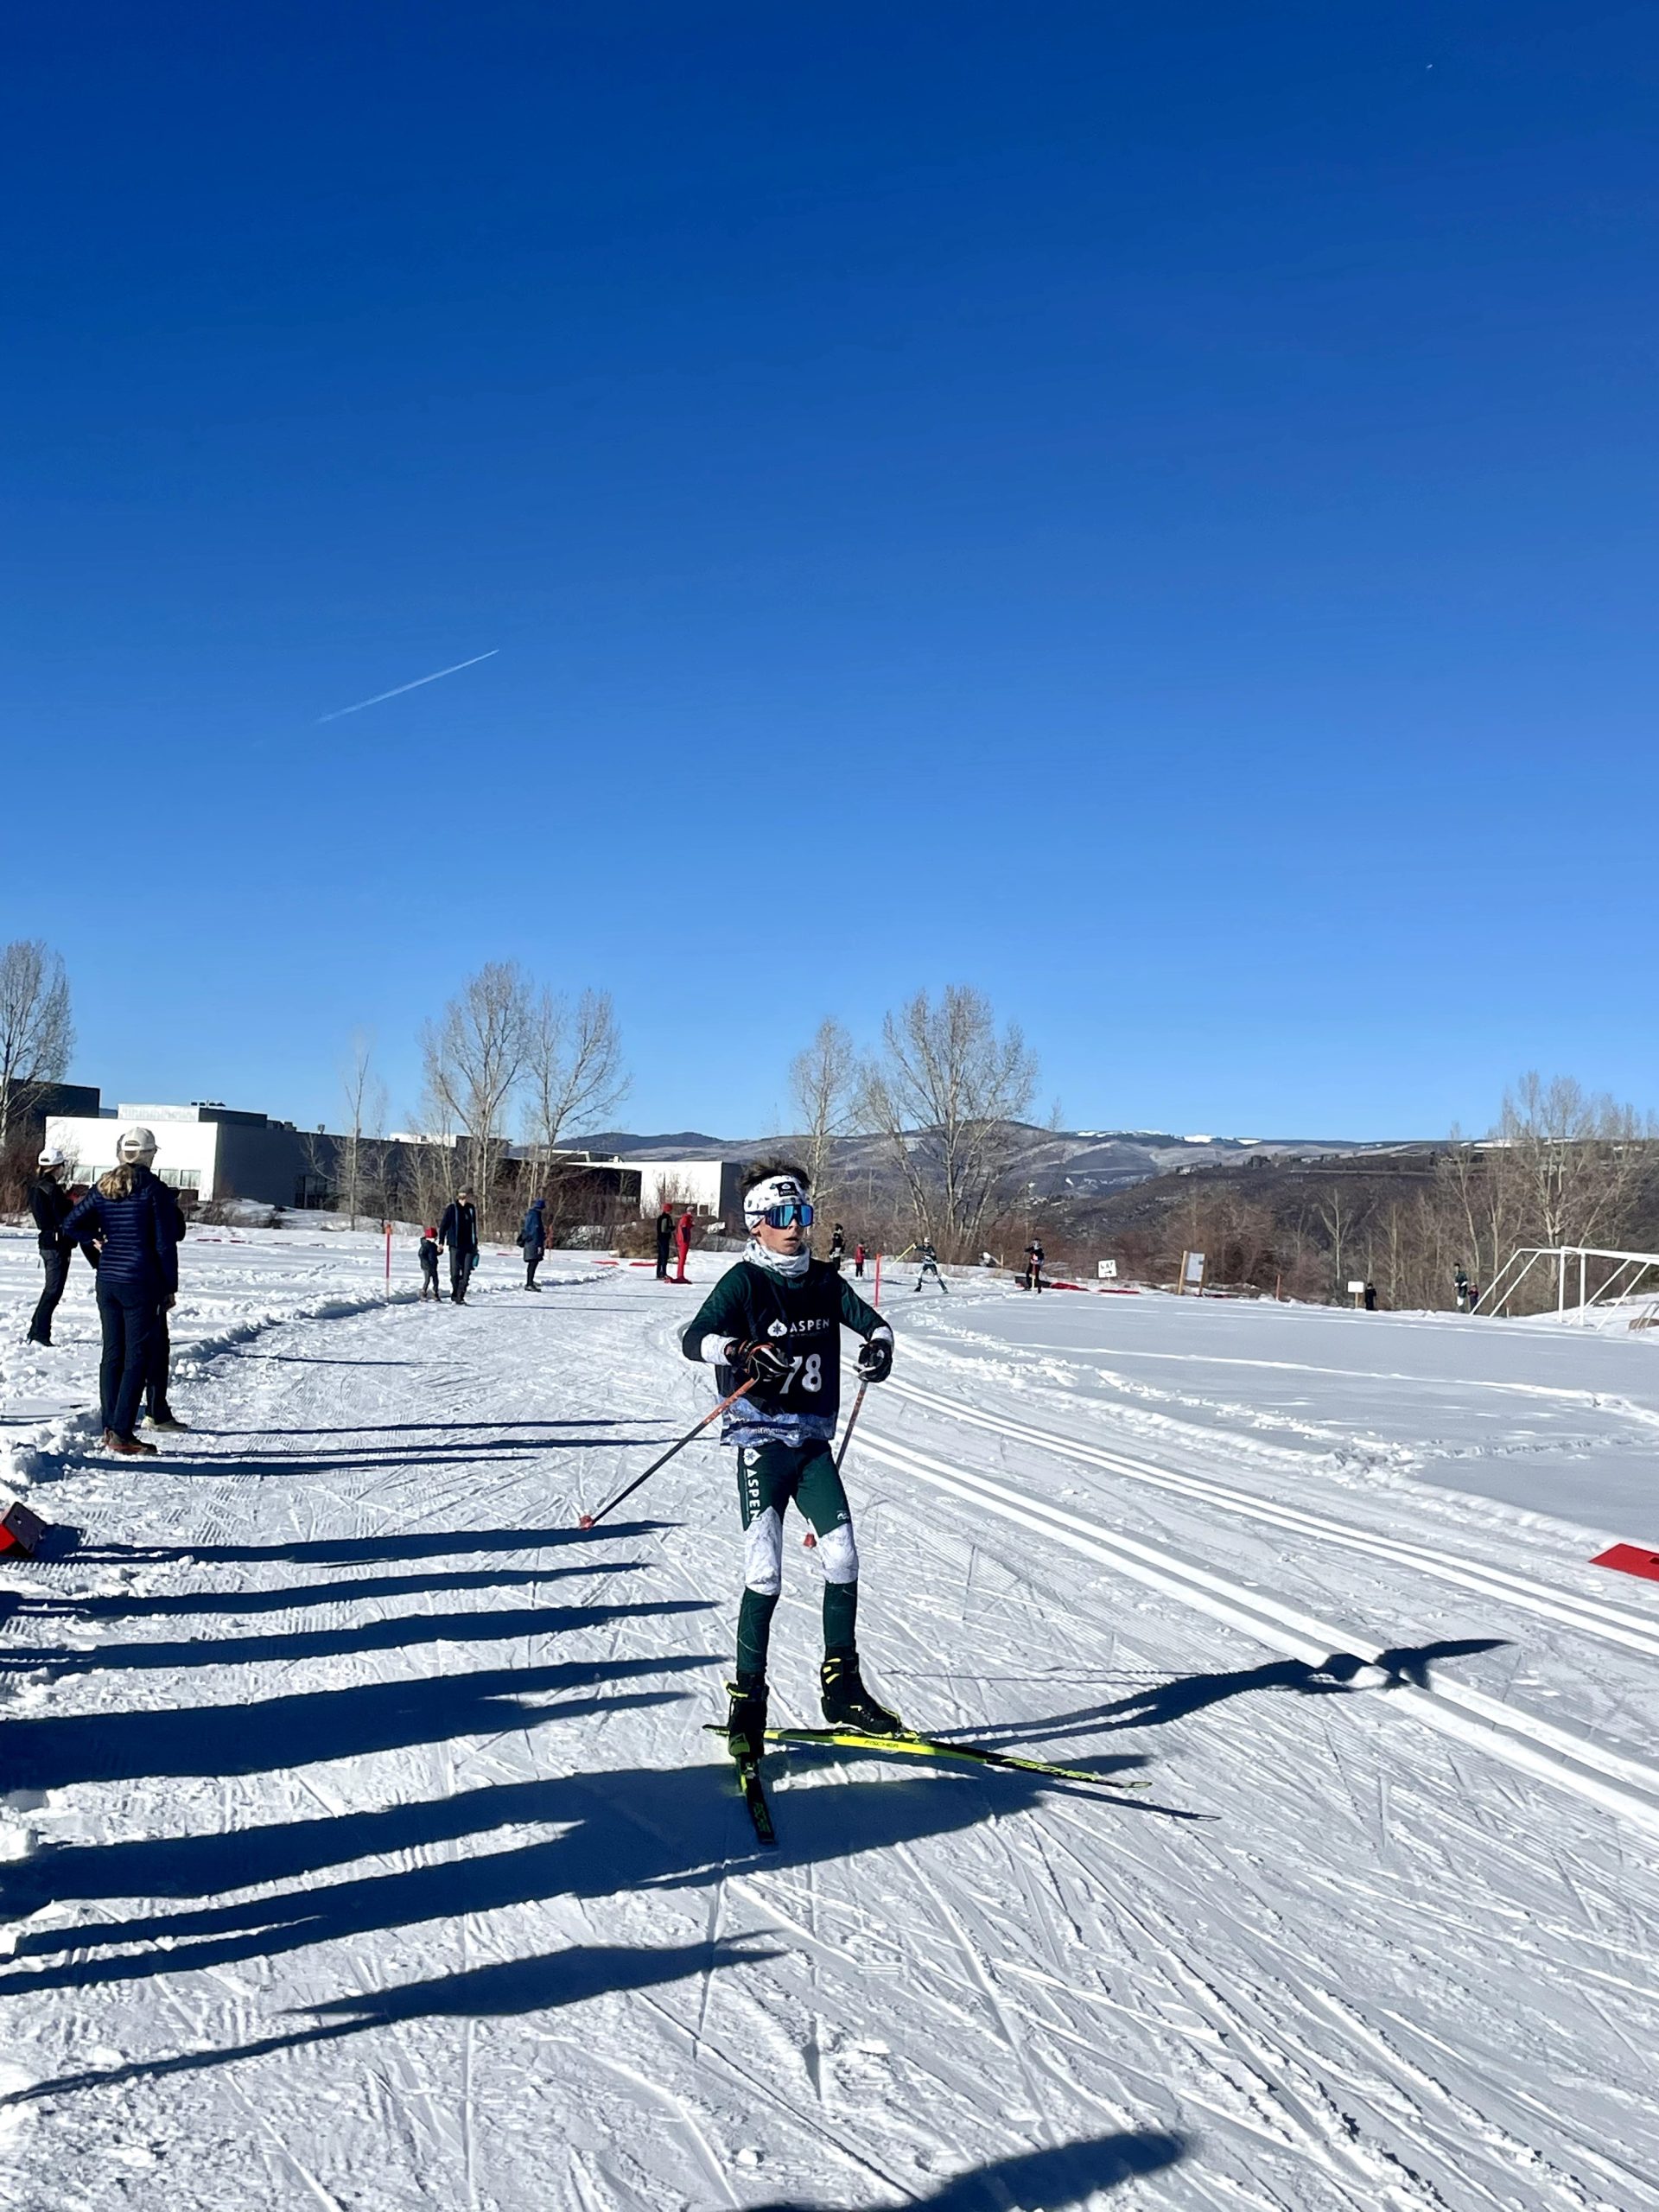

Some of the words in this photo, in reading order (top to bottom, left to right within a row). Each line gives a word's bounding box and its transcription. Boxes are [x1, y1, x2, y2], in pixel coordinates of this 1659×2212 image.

[790, 1318, 830, 1332] ASPEN
[779, 1353, 822, 1394] 78
[746, 1468, 762, 1522] ASPEN
